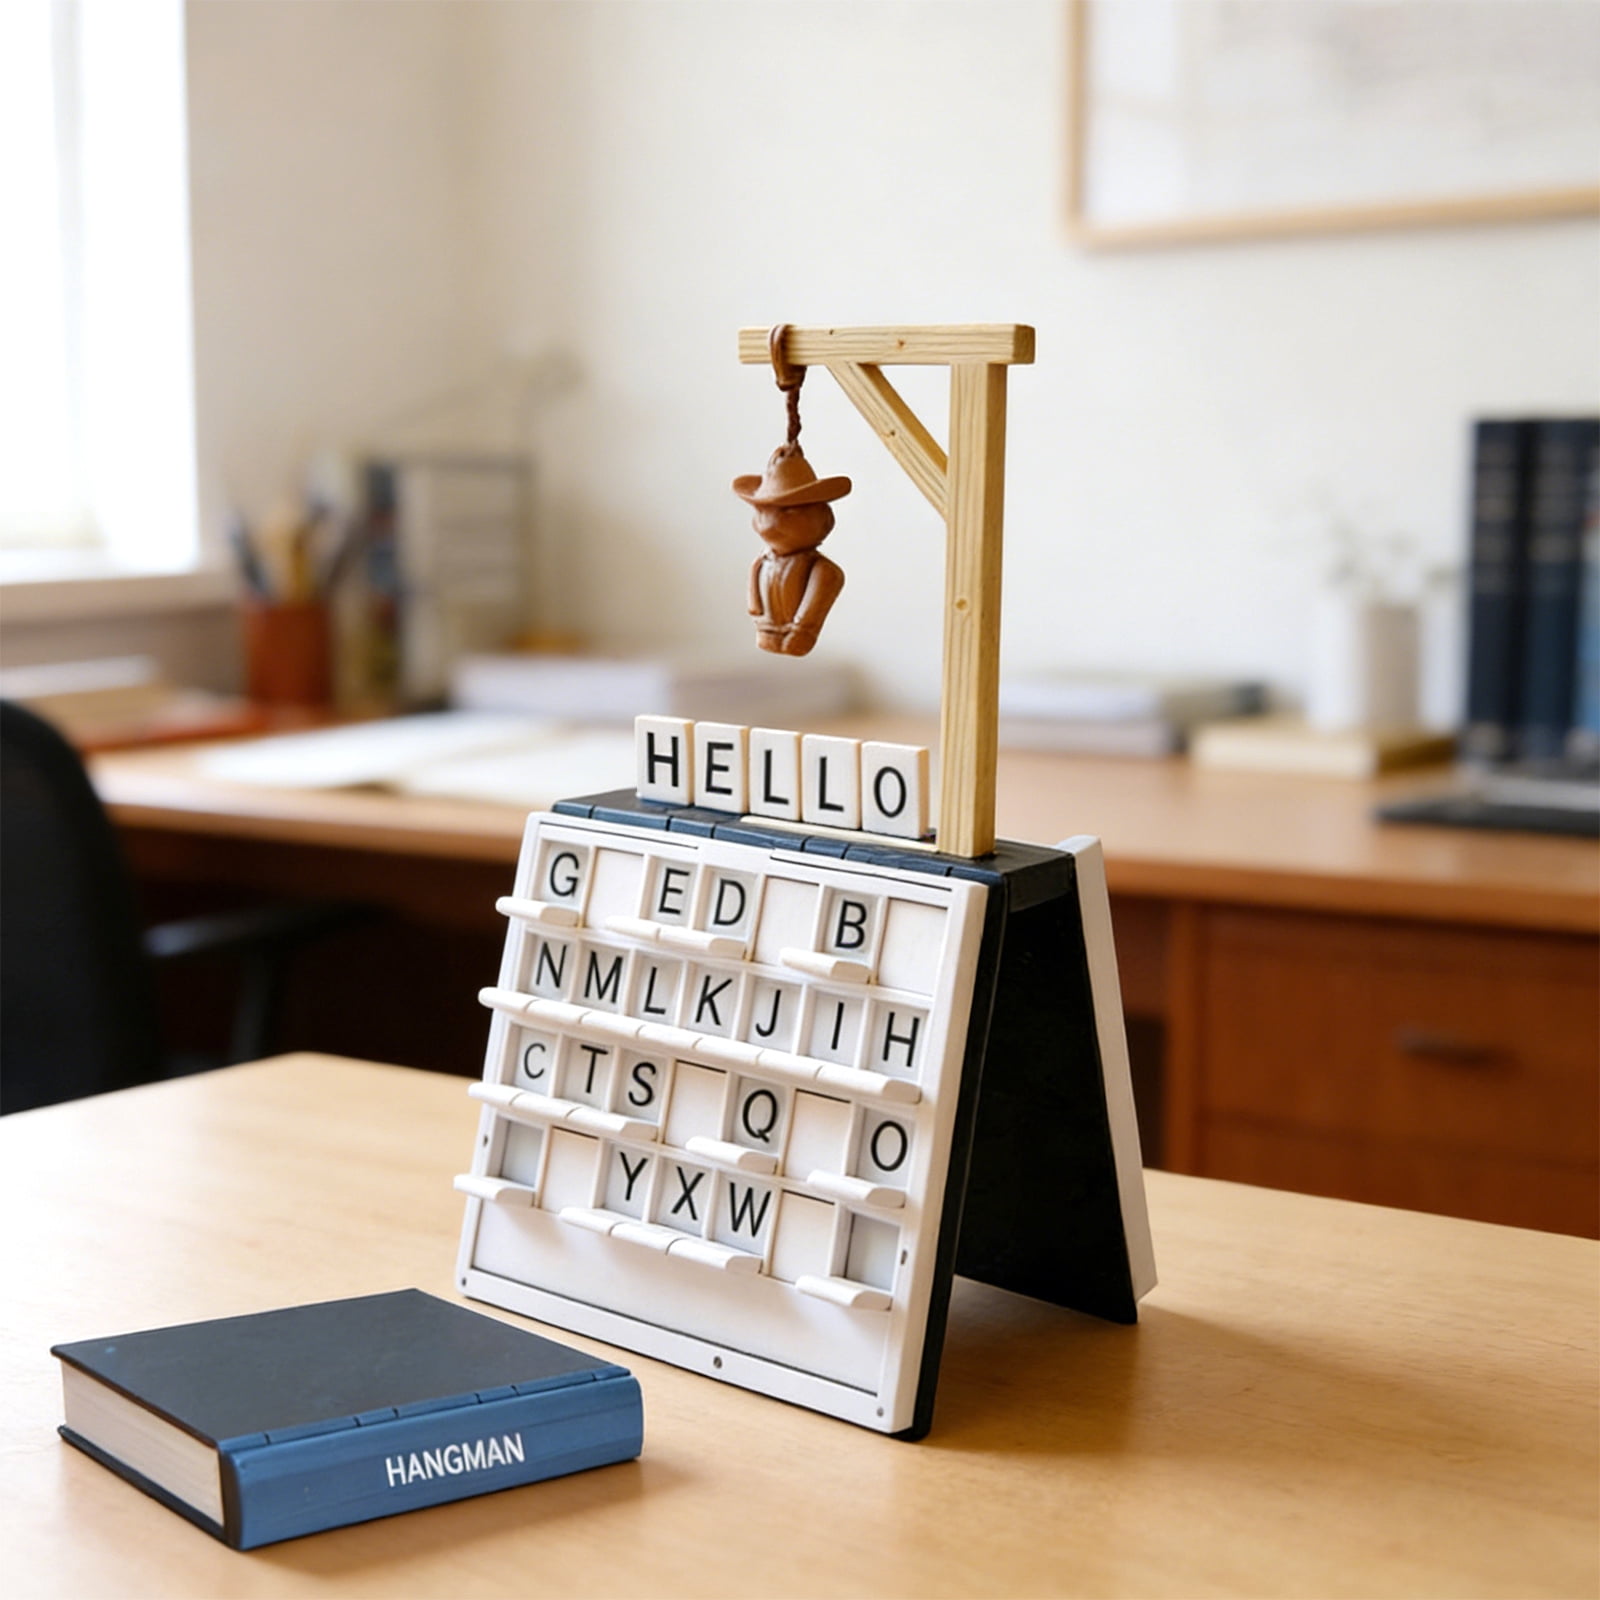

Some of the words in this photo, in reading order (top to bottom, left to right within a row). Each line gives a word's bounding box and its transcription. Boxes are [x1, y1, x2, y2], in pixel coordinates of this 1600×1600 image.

[646, 731, 907, 818] HELLO
[549, 851, 580, 897] G
[658, 868, 690, 916] E
[713, 878, 747, 926] D
[834, 899, 868, 949] B
[535, 940, 568, 988] N
[584, 950, 624, 1004] M
[643, 967, 666, 1015] L
[695, 976, 733, 1026] K
[755, 989, 781, 1037] J
[830, 1001, 845, 1051] I
[881, 1011, 921, 1068] H
[523, 1042, 546, 1080] C
[580, 1044, 609, 1094] T
[627, 1061, 656, 1107] S
[741, 1088, 778, 1143] Q
[869, 1120, 908, 1172] O
[619, 1151, 648, 1202] Y
[670, 1166, 704, 1221] X
[728, 1181, 771, 1238] W
[385, 1432, 525, 1488] HANGMAN
